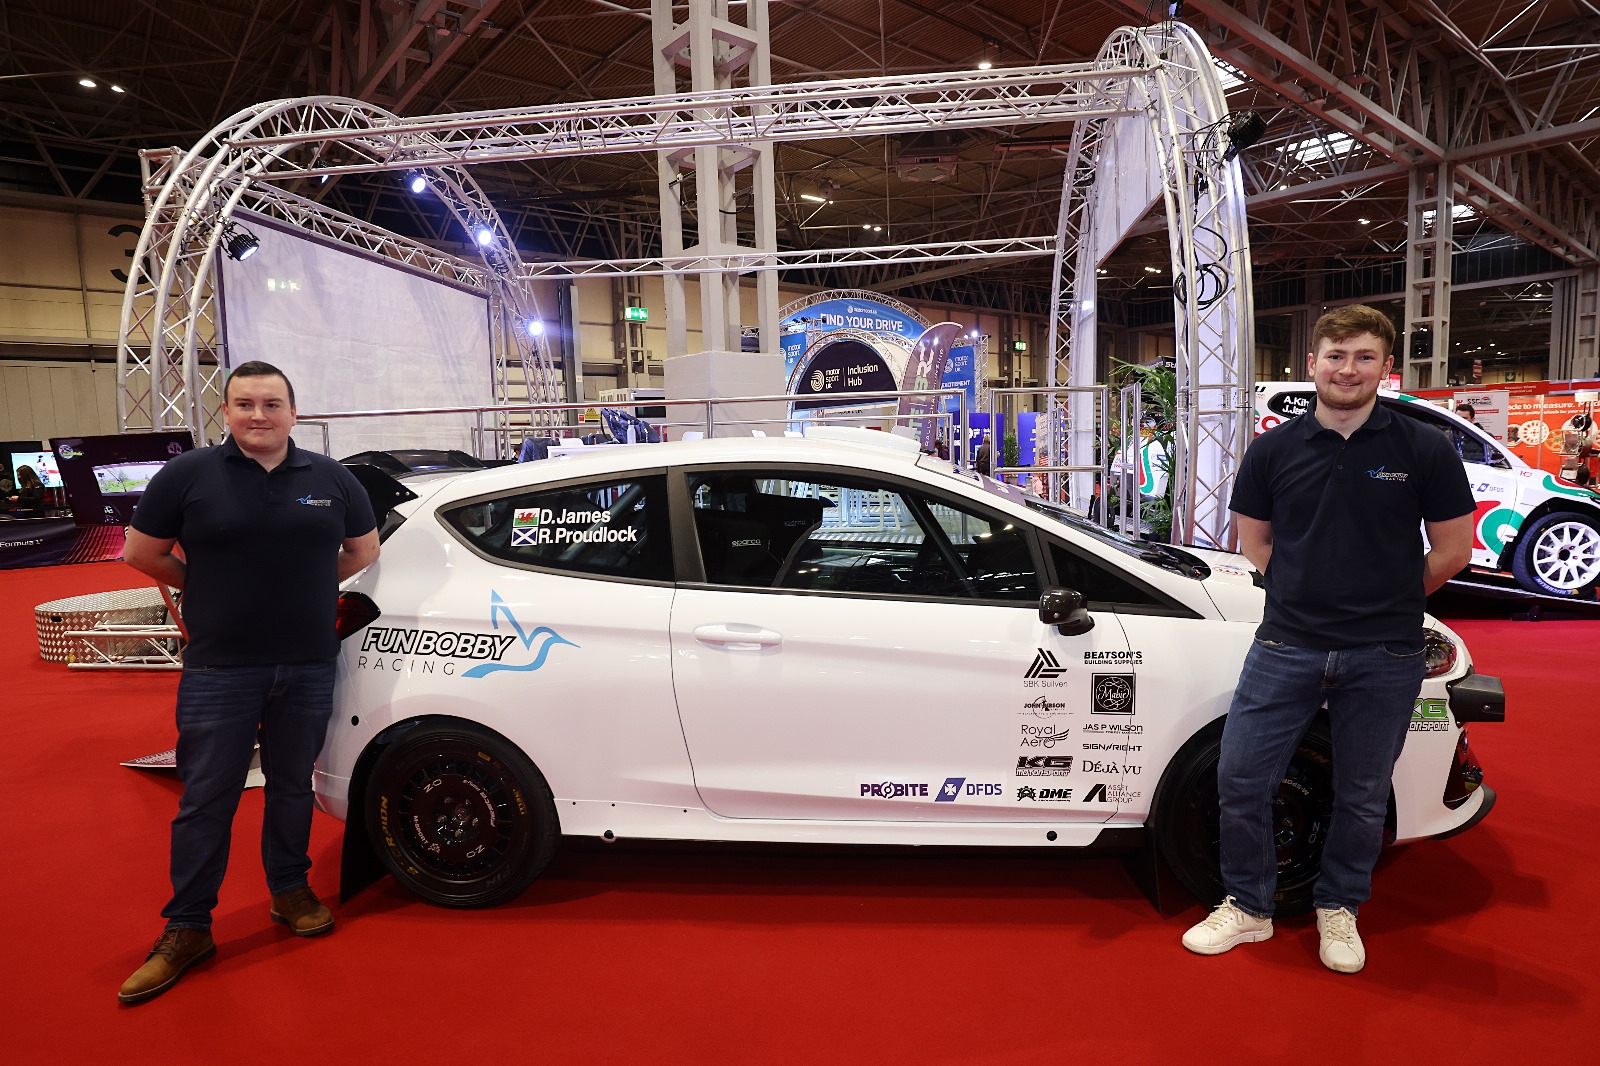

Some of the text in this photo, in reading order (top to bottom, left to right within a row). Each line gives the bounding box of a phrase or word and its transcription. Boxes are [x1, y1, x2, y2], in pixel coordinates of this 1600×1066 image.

[820, 313, 903, 331] FIND YOUR DRIVE
[826, 367, 840, 375] motor
[848, 364, 878, 375] Inclusion
[826, 375, 839, 383] sport
[848, 377, 862, 387] Hub
[1533, 401, 1575, 409] measure.
[540, 508, 611, 525] D.James
[538, 526, 638, 544] R.Proudlock
[1536, 577, 1567, 594] MICHELIN
[361, 627, 516, 661] FUN BOBBY
[1084, 651, 1143, 659] BEATSON'S
[358, 656, 455, 676] RACING
[1023, 680, 1040, 688] SBK
[1021, 724, 1056, 736] Royal
[1109, 724, 1143, 732] WILSON
[1409, 721, 1450, 731] ORSPORT
[1020, 737, 1056, 748] Aero
[1082, 760, 1142, 775] DÉJÀ VU
[966, 783, 1003, 796] DFDS
[1039, 788, 1073, 798] DME
[1108, 790, 1142, 798] ALLIANCE
